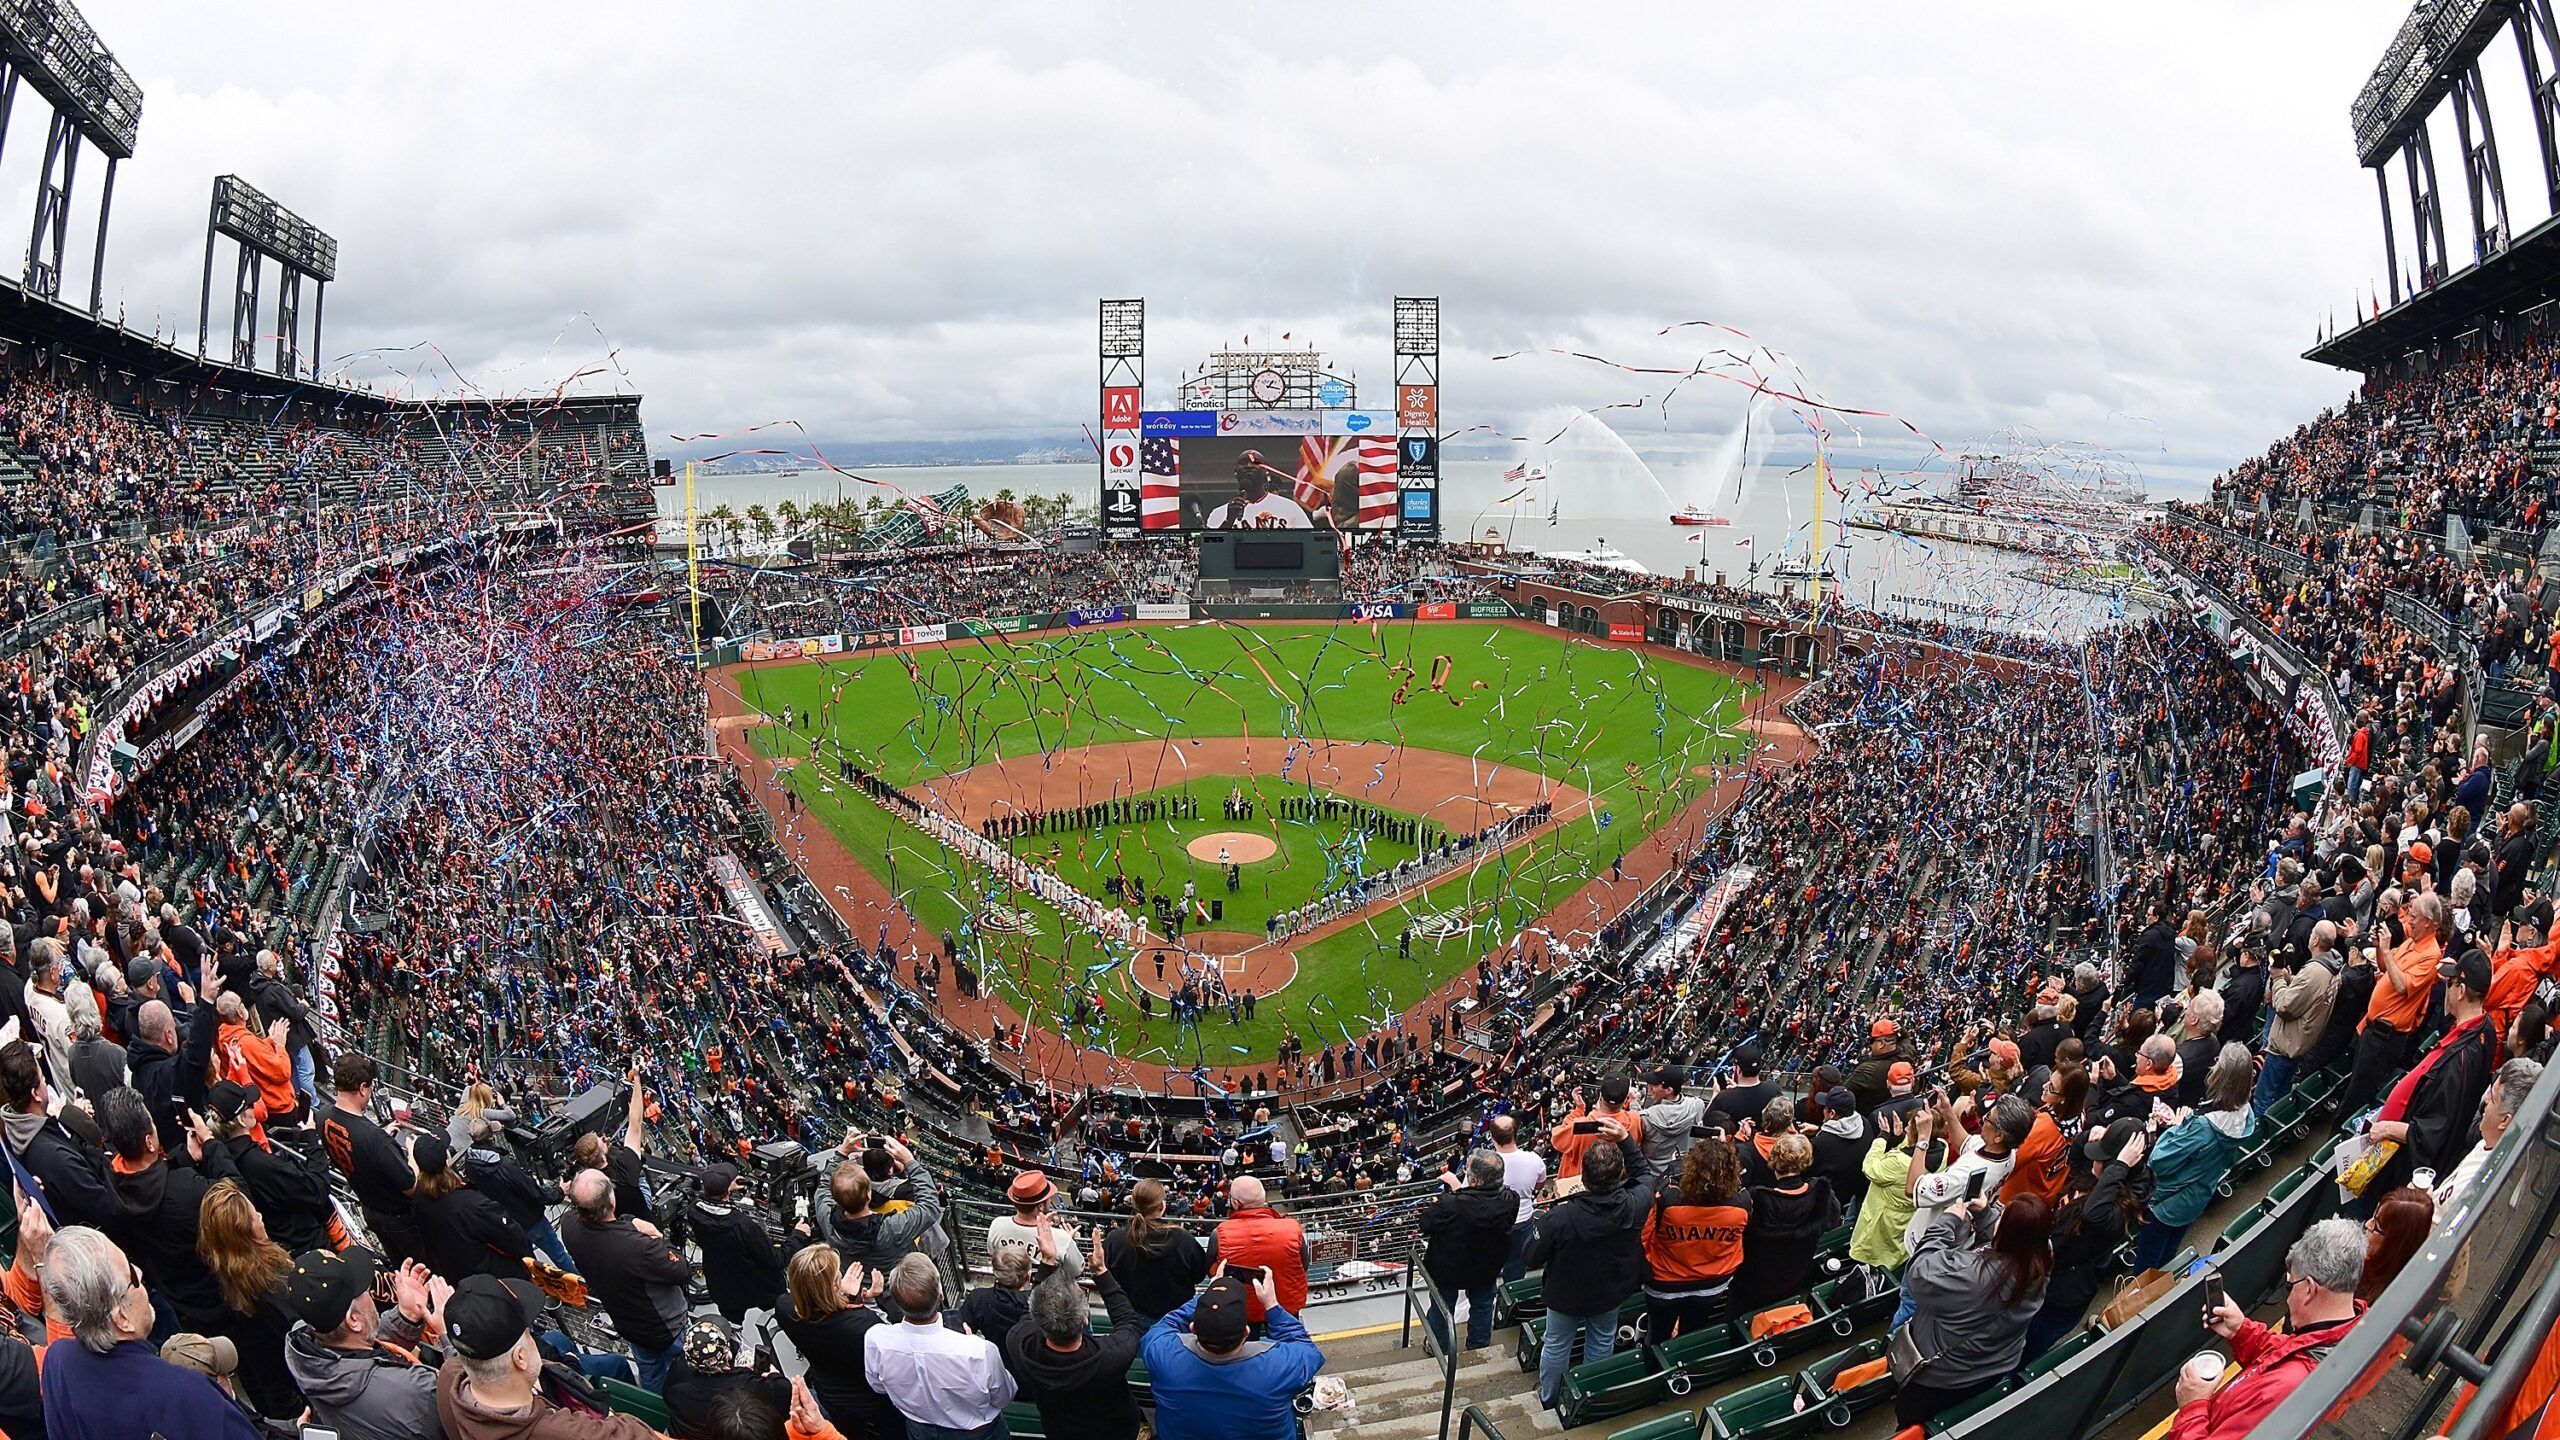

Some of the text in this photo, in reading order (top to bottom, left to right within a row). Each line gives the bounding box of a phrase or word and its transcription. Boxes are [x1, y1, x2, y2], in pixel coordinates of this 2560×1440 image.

[1218, 352, 1320, 374] ORACLE PARK
[1321, 385, 1345, 393] coupa
[1186, 399, 1225, 409] Fanatics
[1111, 415, 1132, 423] Adobe
[1404, 410, 1430, 420] Dignity
[1145, 422, 1177, 430] workday
[1891, 593, 1916, 605] BANK
[1078, 607, 1114, 621] YAHOO!
[1361, 603, 1394, 619] VISA
[1470, 605, 1508, 613] BIOFREEZE
[1692, 601, 1742, 621] LANDING
[985, 618, 1021, 633] National
[916, 630, 944, 638] TOYOTA
[2267, 665, 2287, 697] LEXUS
[1665, 1226, 1740, 1241] GIANTS
[1362, 1276, 1400, 1293] 314
[1312, 1284, 1348, 1301] 315
